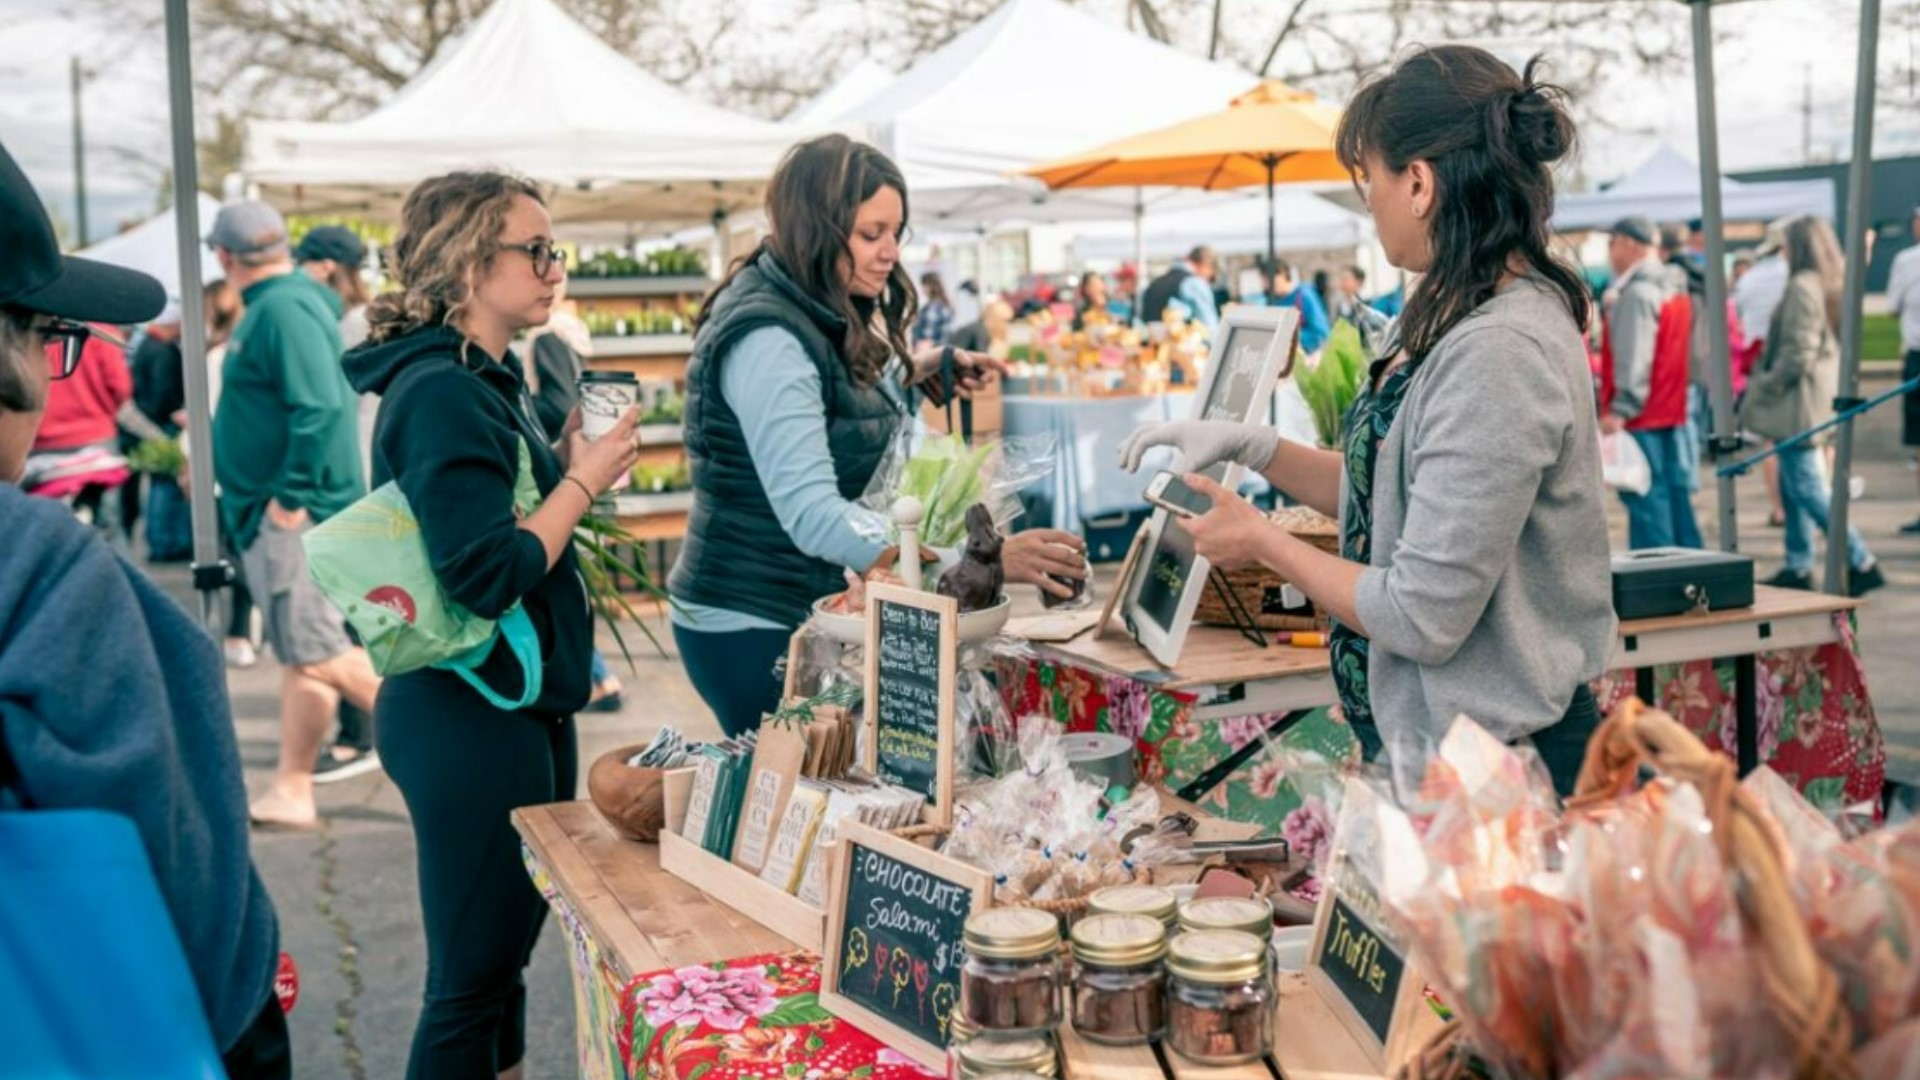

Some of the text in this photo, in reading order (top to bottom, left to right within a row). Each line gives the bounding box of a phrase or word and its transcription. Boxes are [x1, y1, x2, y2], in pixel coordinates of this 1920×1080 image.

[865, 853, 965, 915] CHOCOLATE
[866, 897, 940, 941] Salami
[1328, 908, 1387, 994] Truffles
